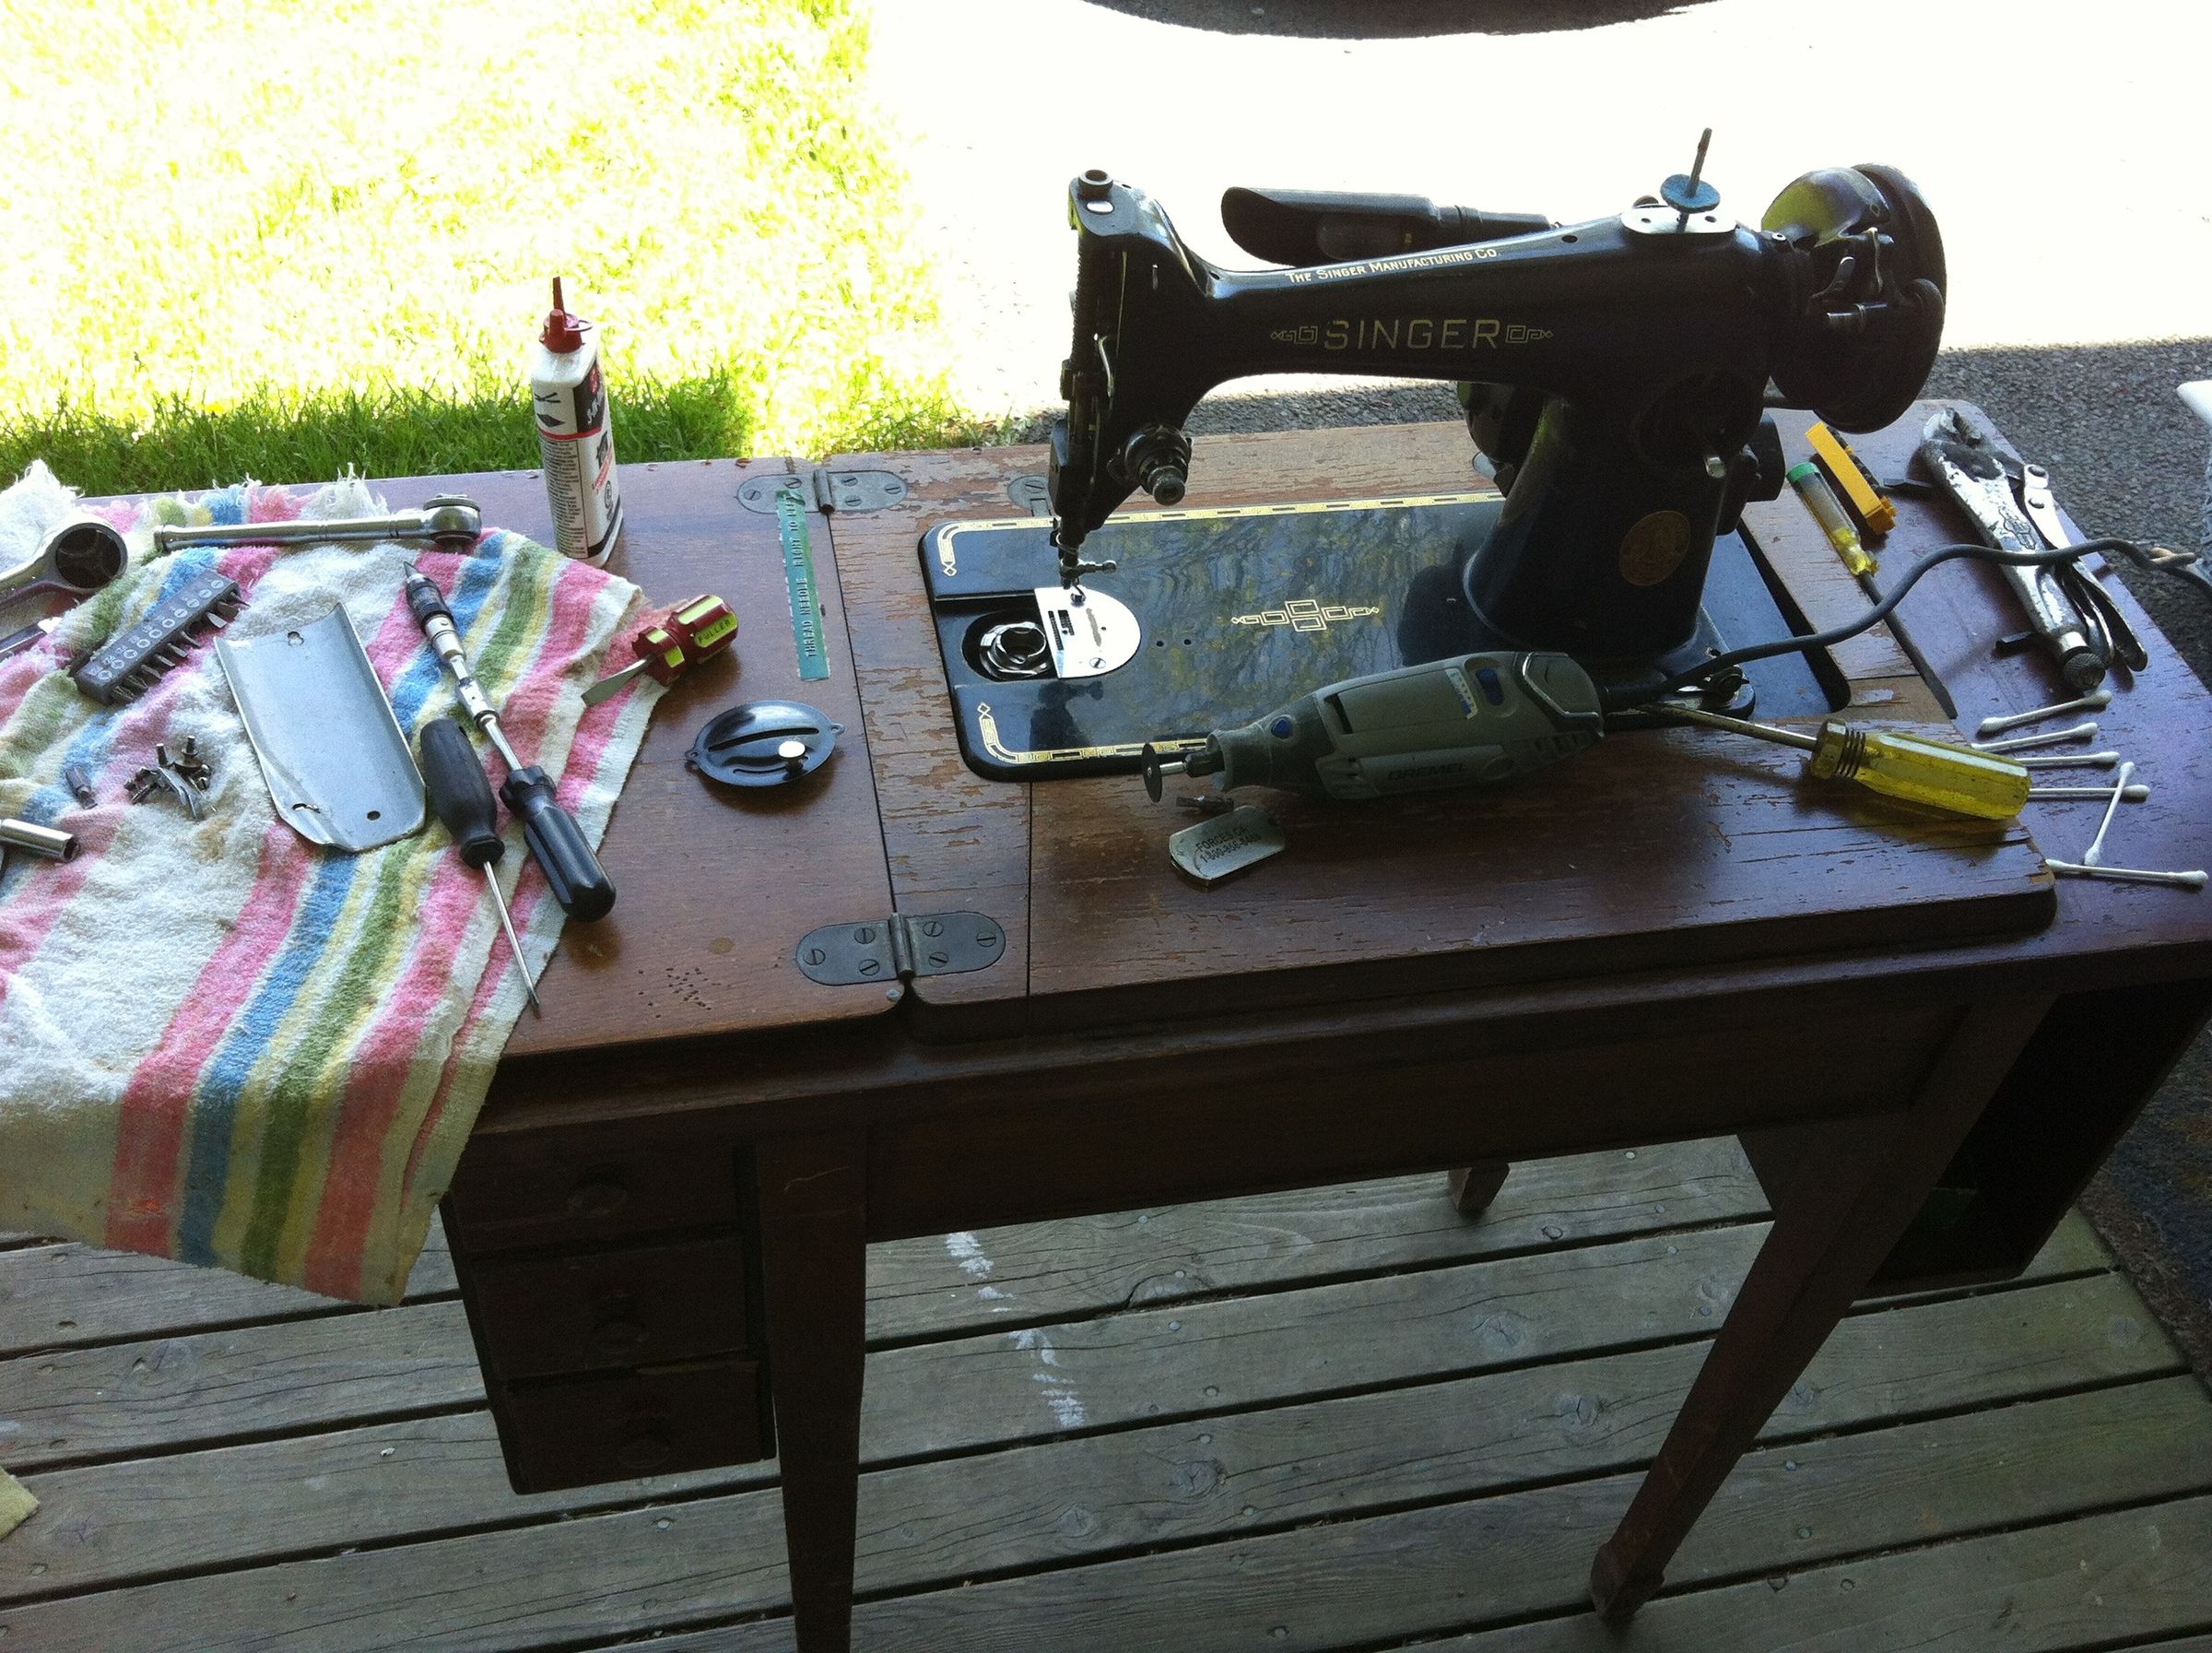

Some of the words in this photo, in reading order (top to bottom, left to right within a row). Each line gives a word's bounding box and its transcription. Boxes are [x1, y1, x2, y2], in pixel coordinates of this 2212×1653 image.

[1285, 271, 1312, 284] THE
[1316, 266, 1366, 280] SINGER
[1369, 252, 1474, 274] MANUFACTURING
[1324, 319, 1500, 350] SINGER
[790, 537, 805, 567] RIGHT
[795, 577, 811, 616] NEEDLE
[697, 618, 732, 644] FULLER
[802, 620, 817, 657] THREAD
[1388, 762, 1466, 781] DREMEL
